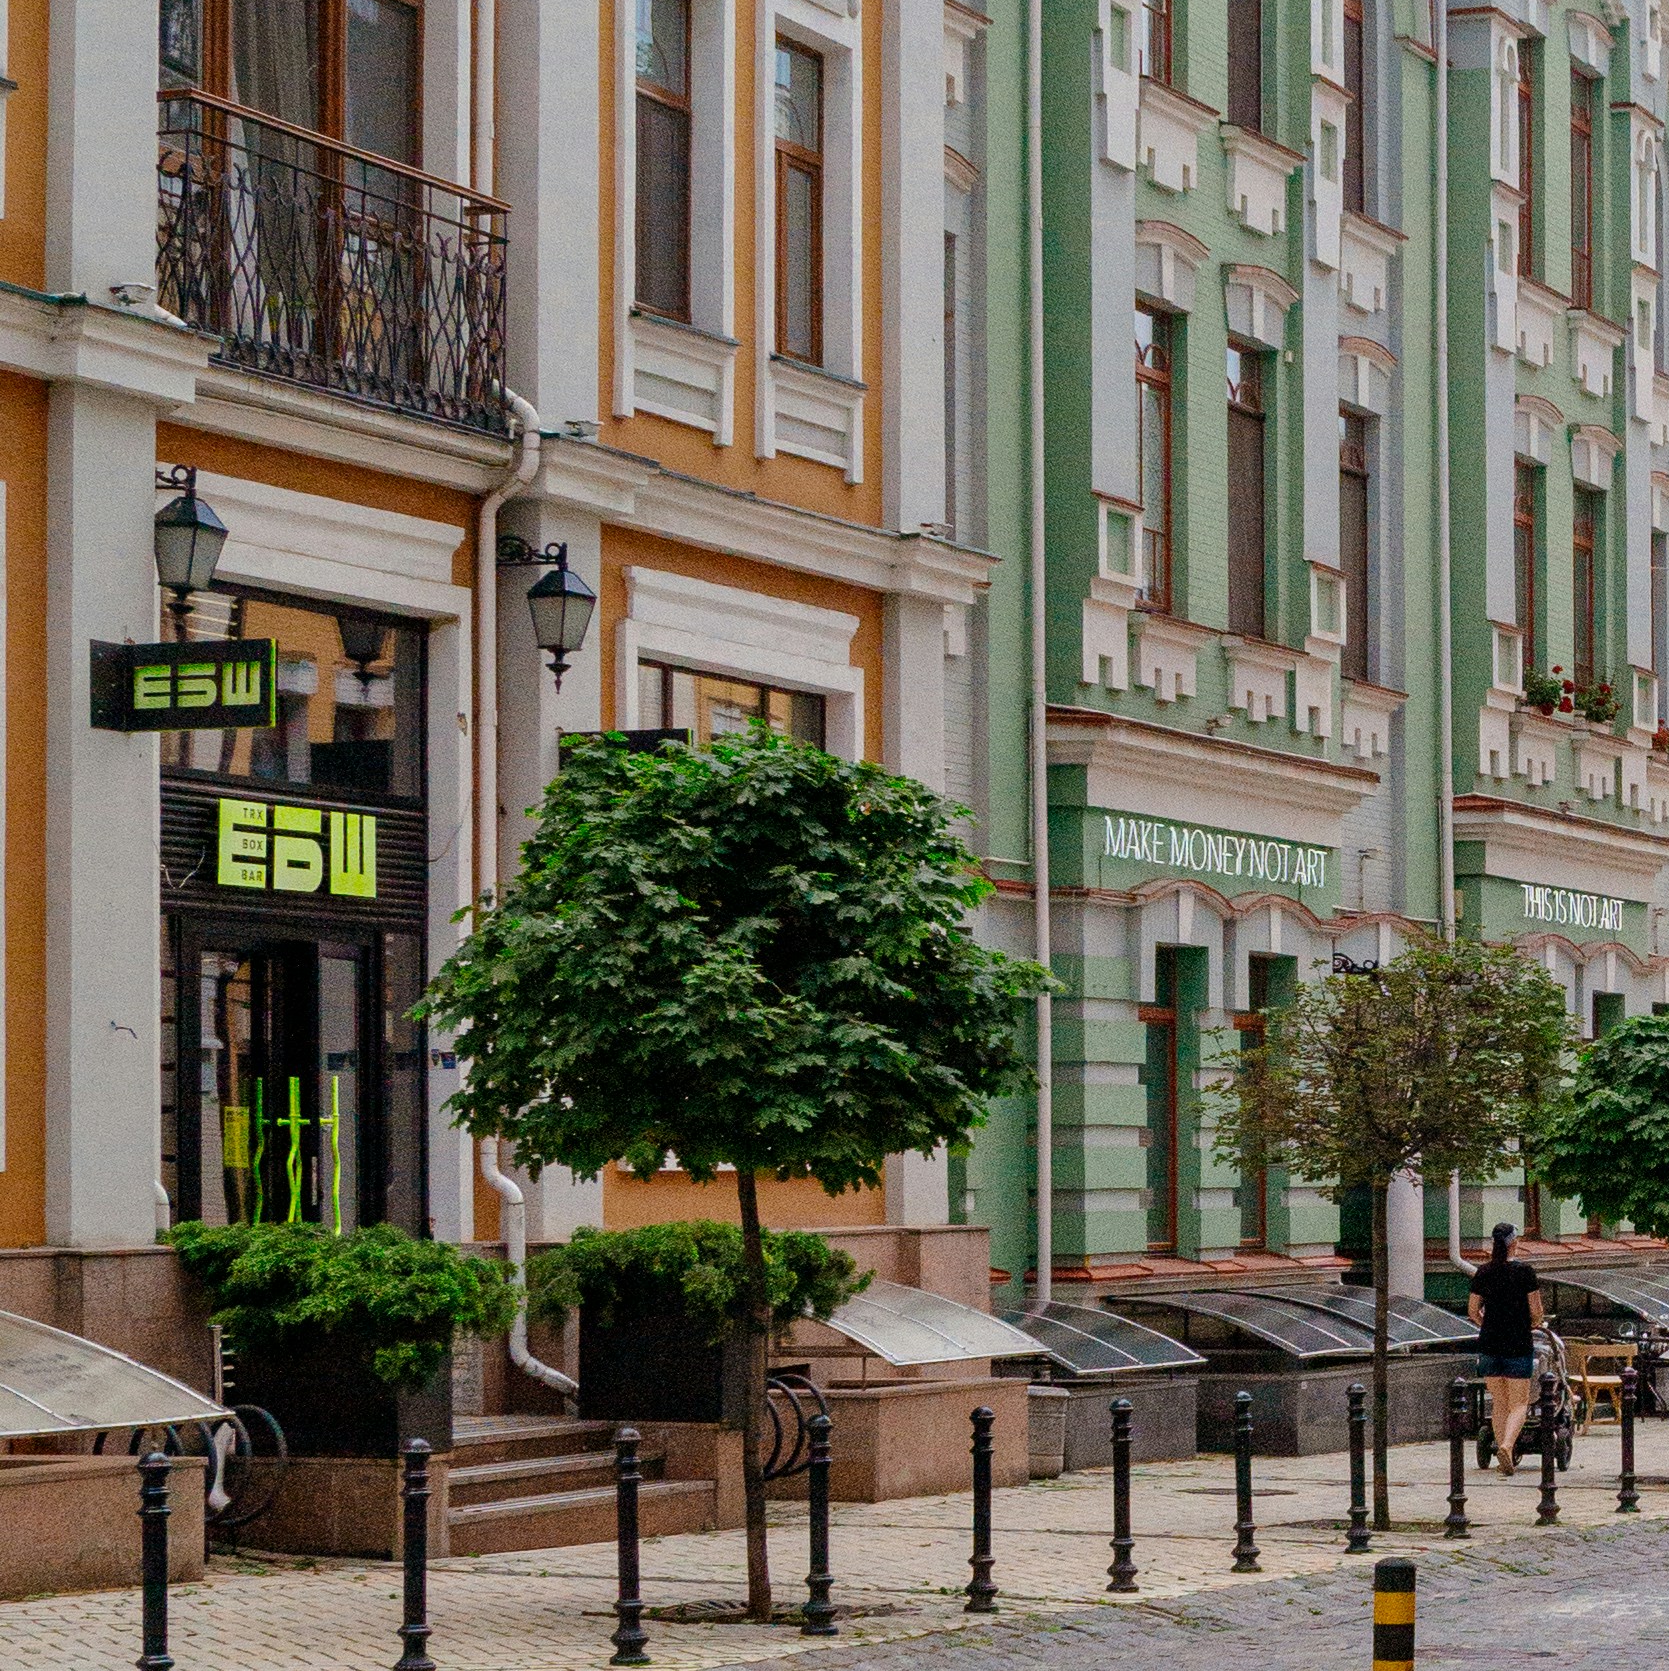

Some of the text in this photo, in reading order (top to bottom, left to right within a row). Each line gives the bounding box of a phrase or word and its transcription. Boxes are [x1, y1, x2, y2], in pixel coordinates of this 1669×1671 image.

[242, 807, 263, 821] TRX
[242, 838, 264, 851] BOX
[1104, 815, 1328, 889] MAKE MONEY NOT ART
[241, 869, 263, 882] BAR
[1520, 884, 1625, 932] THIS IS NOT ART
